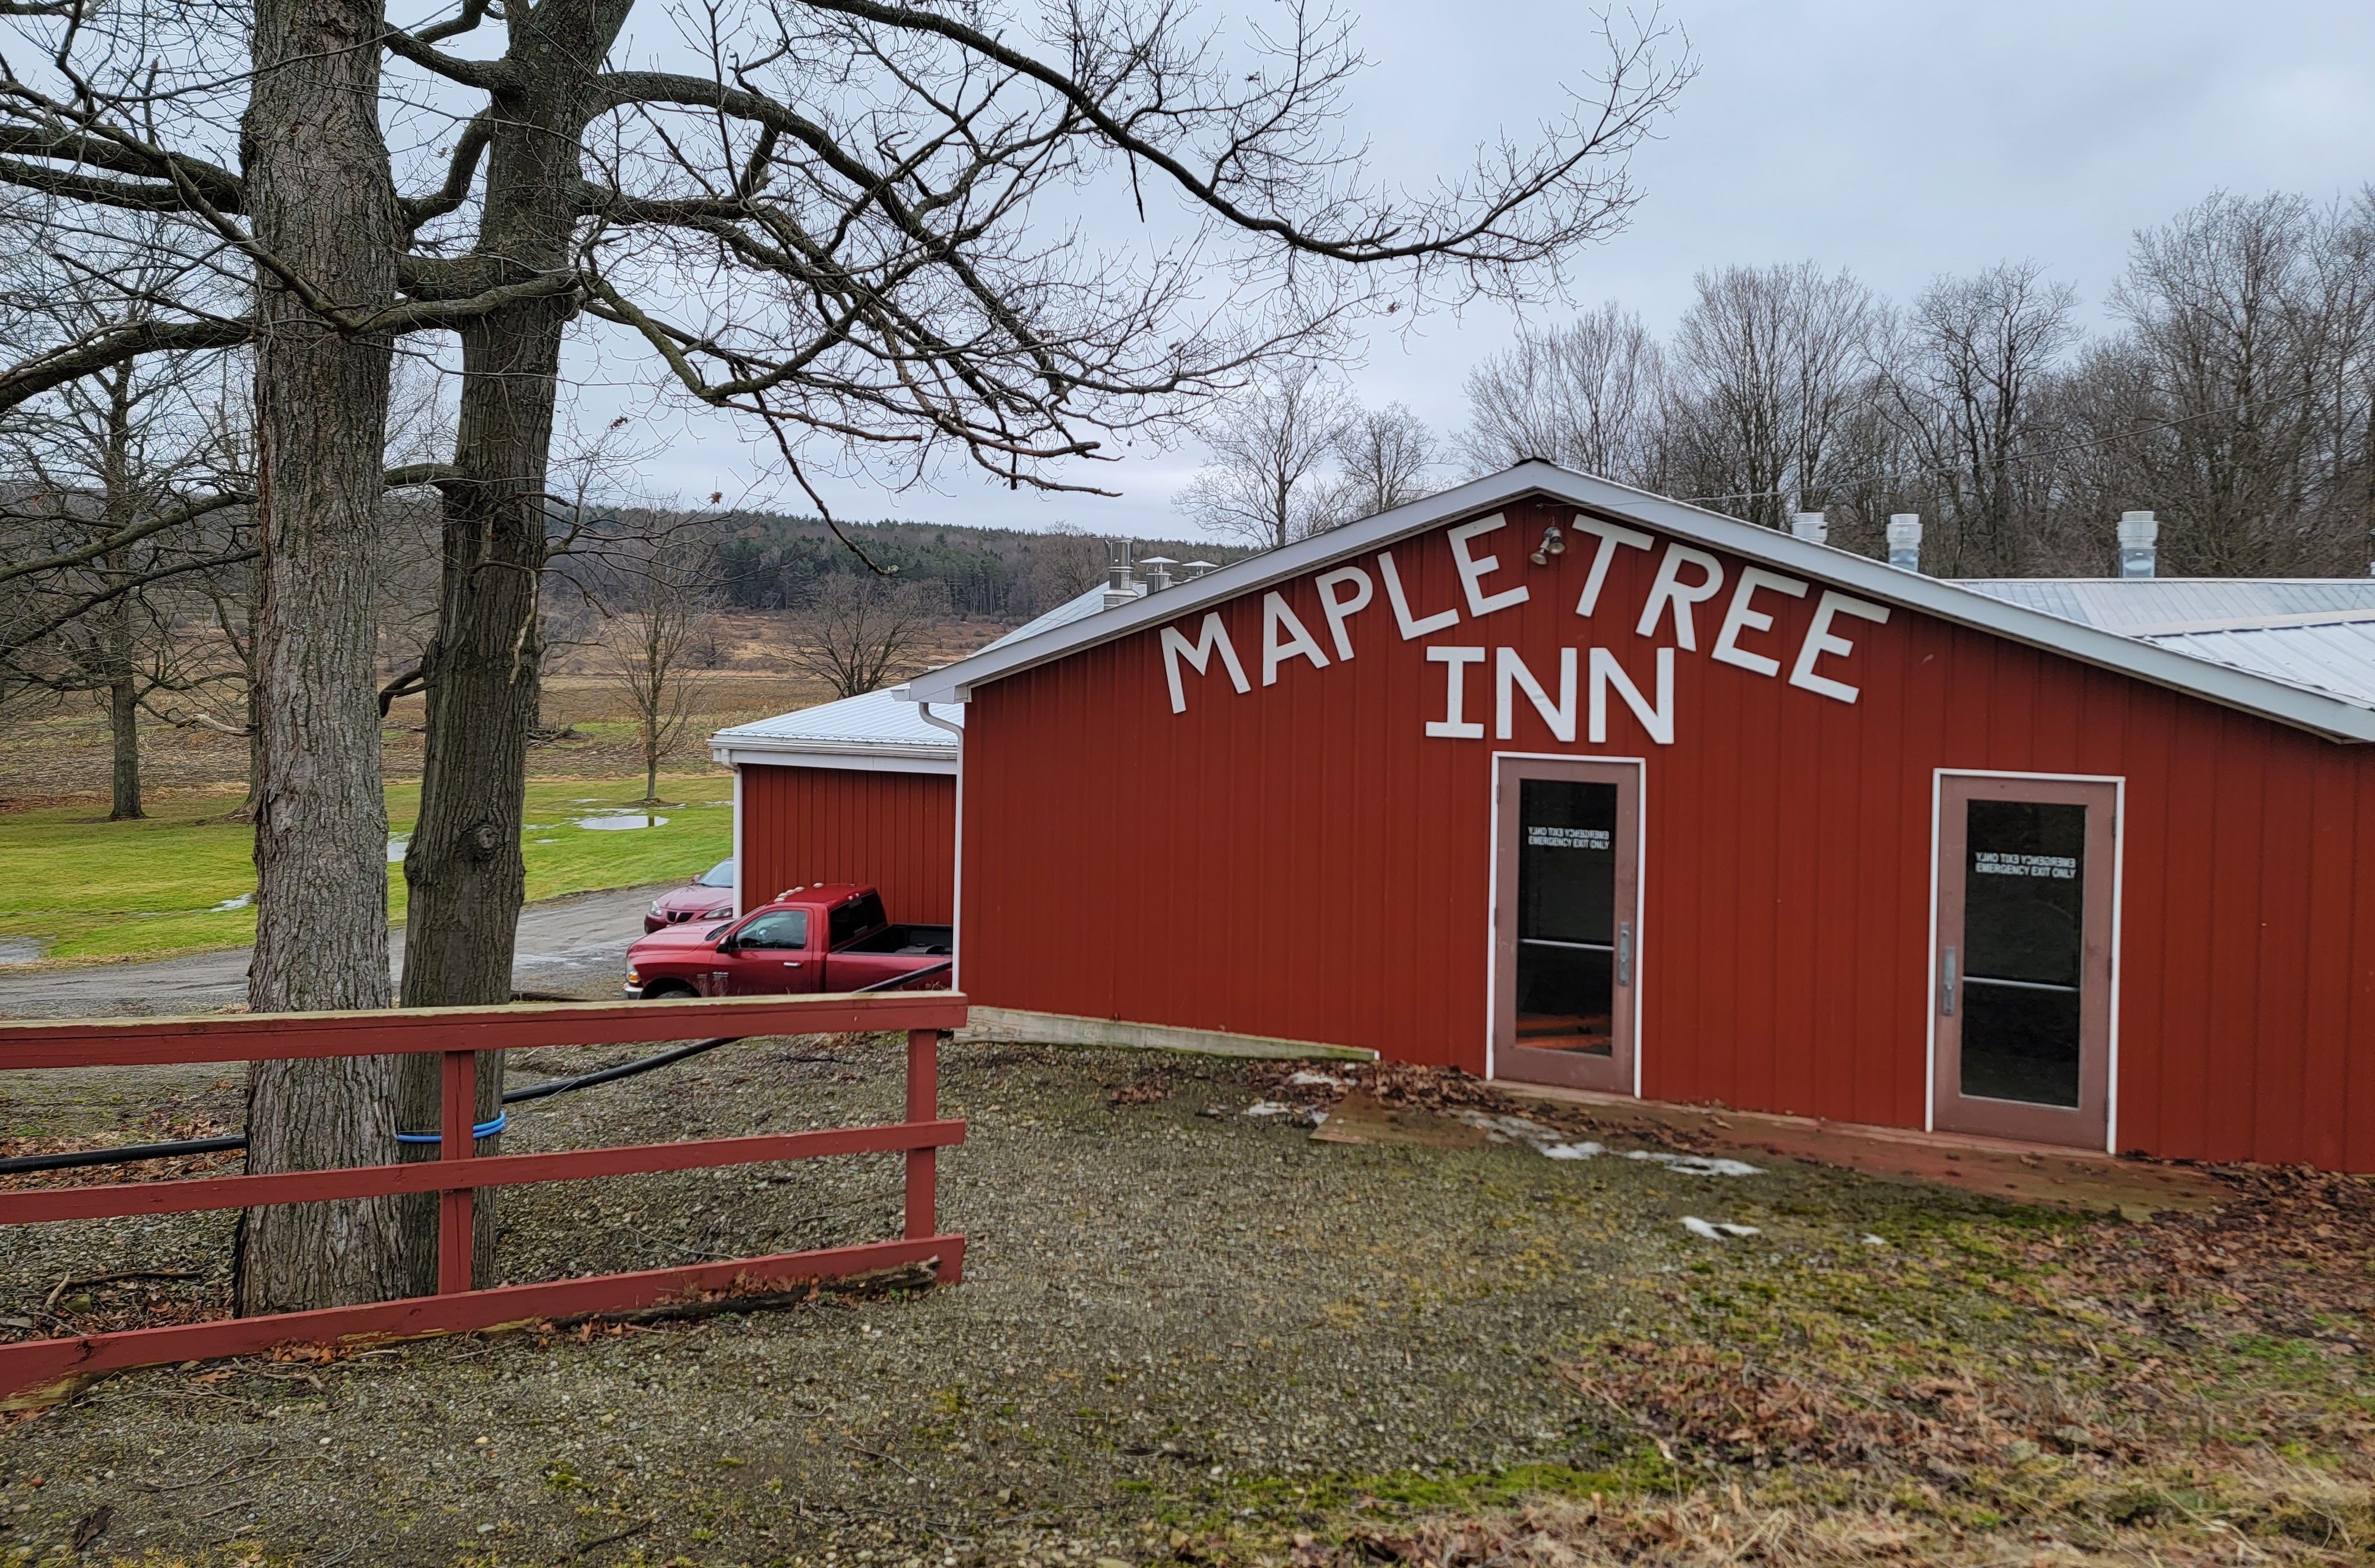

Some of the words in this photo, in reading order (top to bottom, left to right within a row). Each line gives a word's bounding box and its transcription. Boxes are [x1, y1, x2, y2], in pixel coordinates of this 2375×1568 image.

[1160, 512, 1530, 714] MAPLE
[1572, 513, 1890, 704] TREE
[1426, 646, 1674, 745] INN
[1528, 836, 1572, 847] EMERGENCY
[1573, 838, 1589, 848] EXIT
[1589, 840, 1610, 849] ONLY
[1975, 863, 2029, 875] EMERGENCY
[2031, 866, 2051, 876] EXIT
[2051, 868, 2076, 878] ONLY
